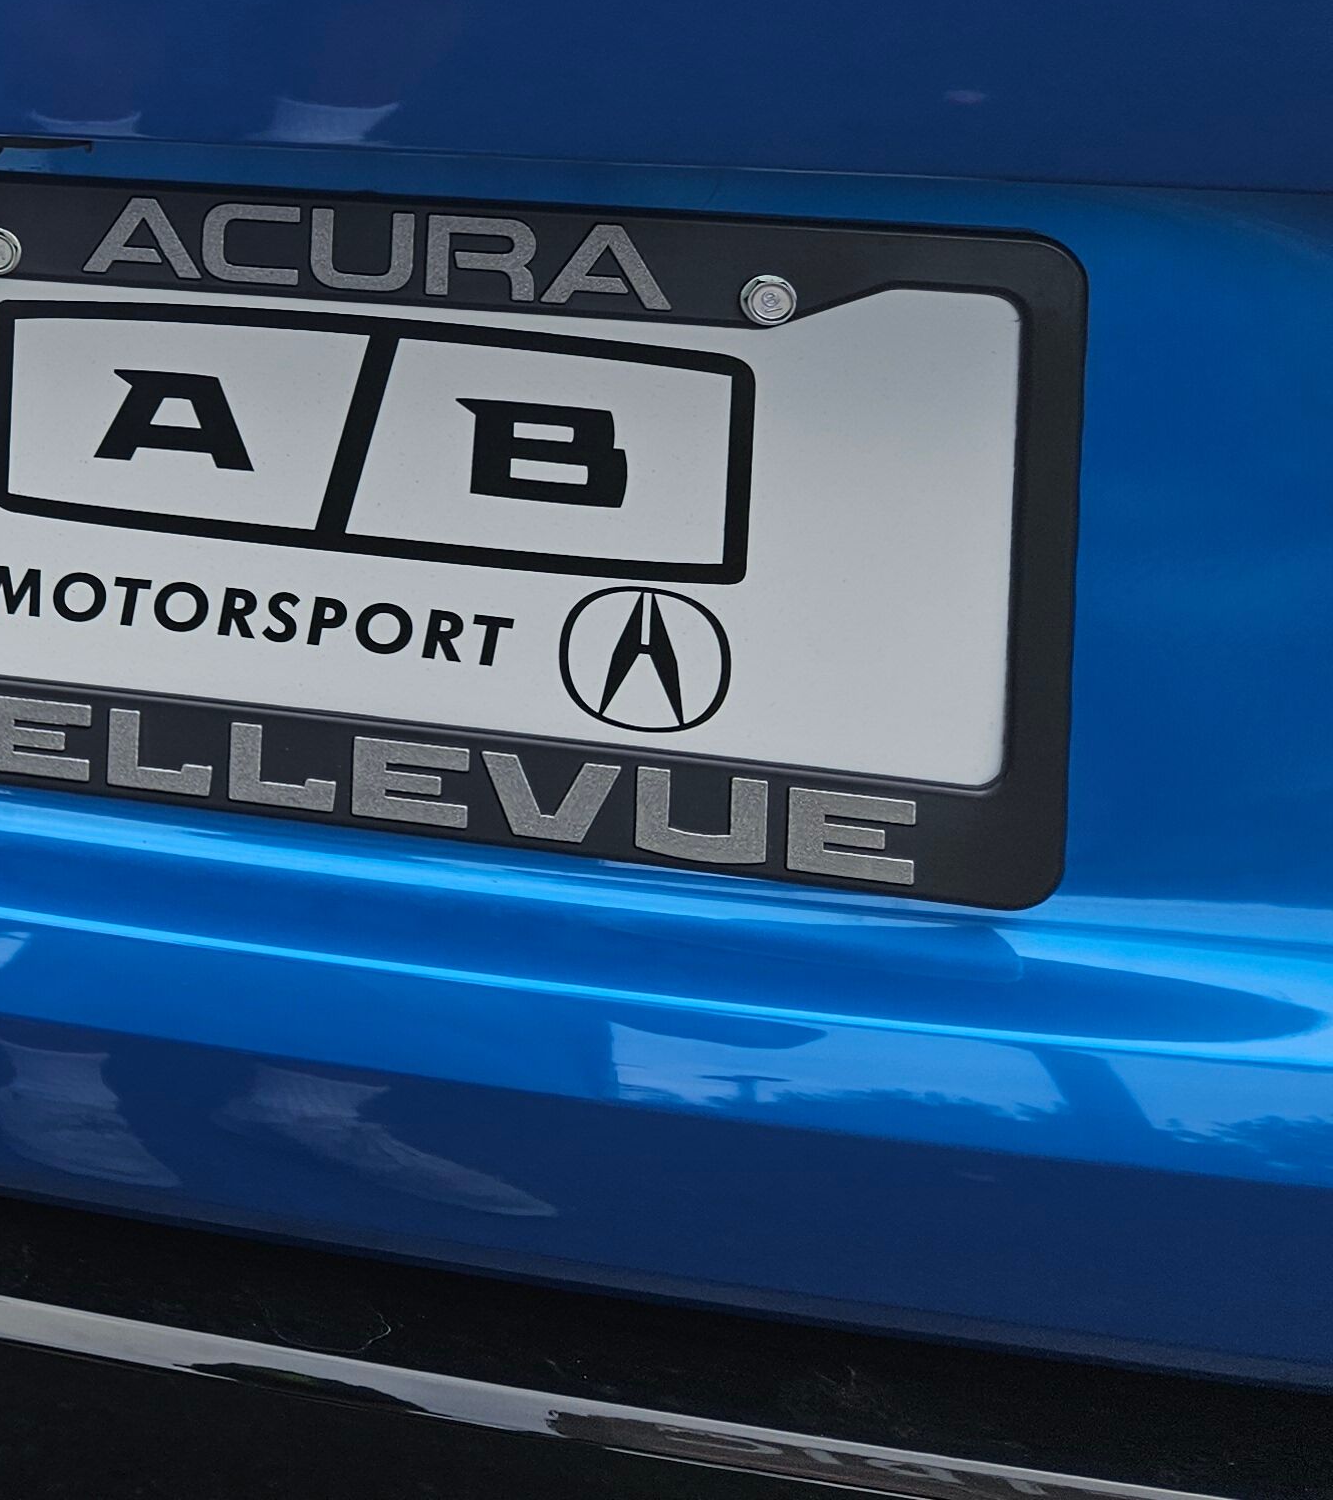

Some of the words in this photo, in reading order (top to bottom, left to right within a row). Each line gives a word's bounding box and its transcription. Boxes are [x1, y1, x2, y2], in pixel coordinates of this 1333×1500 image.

[82, 197, 673, 311] ACURA
[92, 367, 256, 473] A
[454, 396, 629, 510] B
